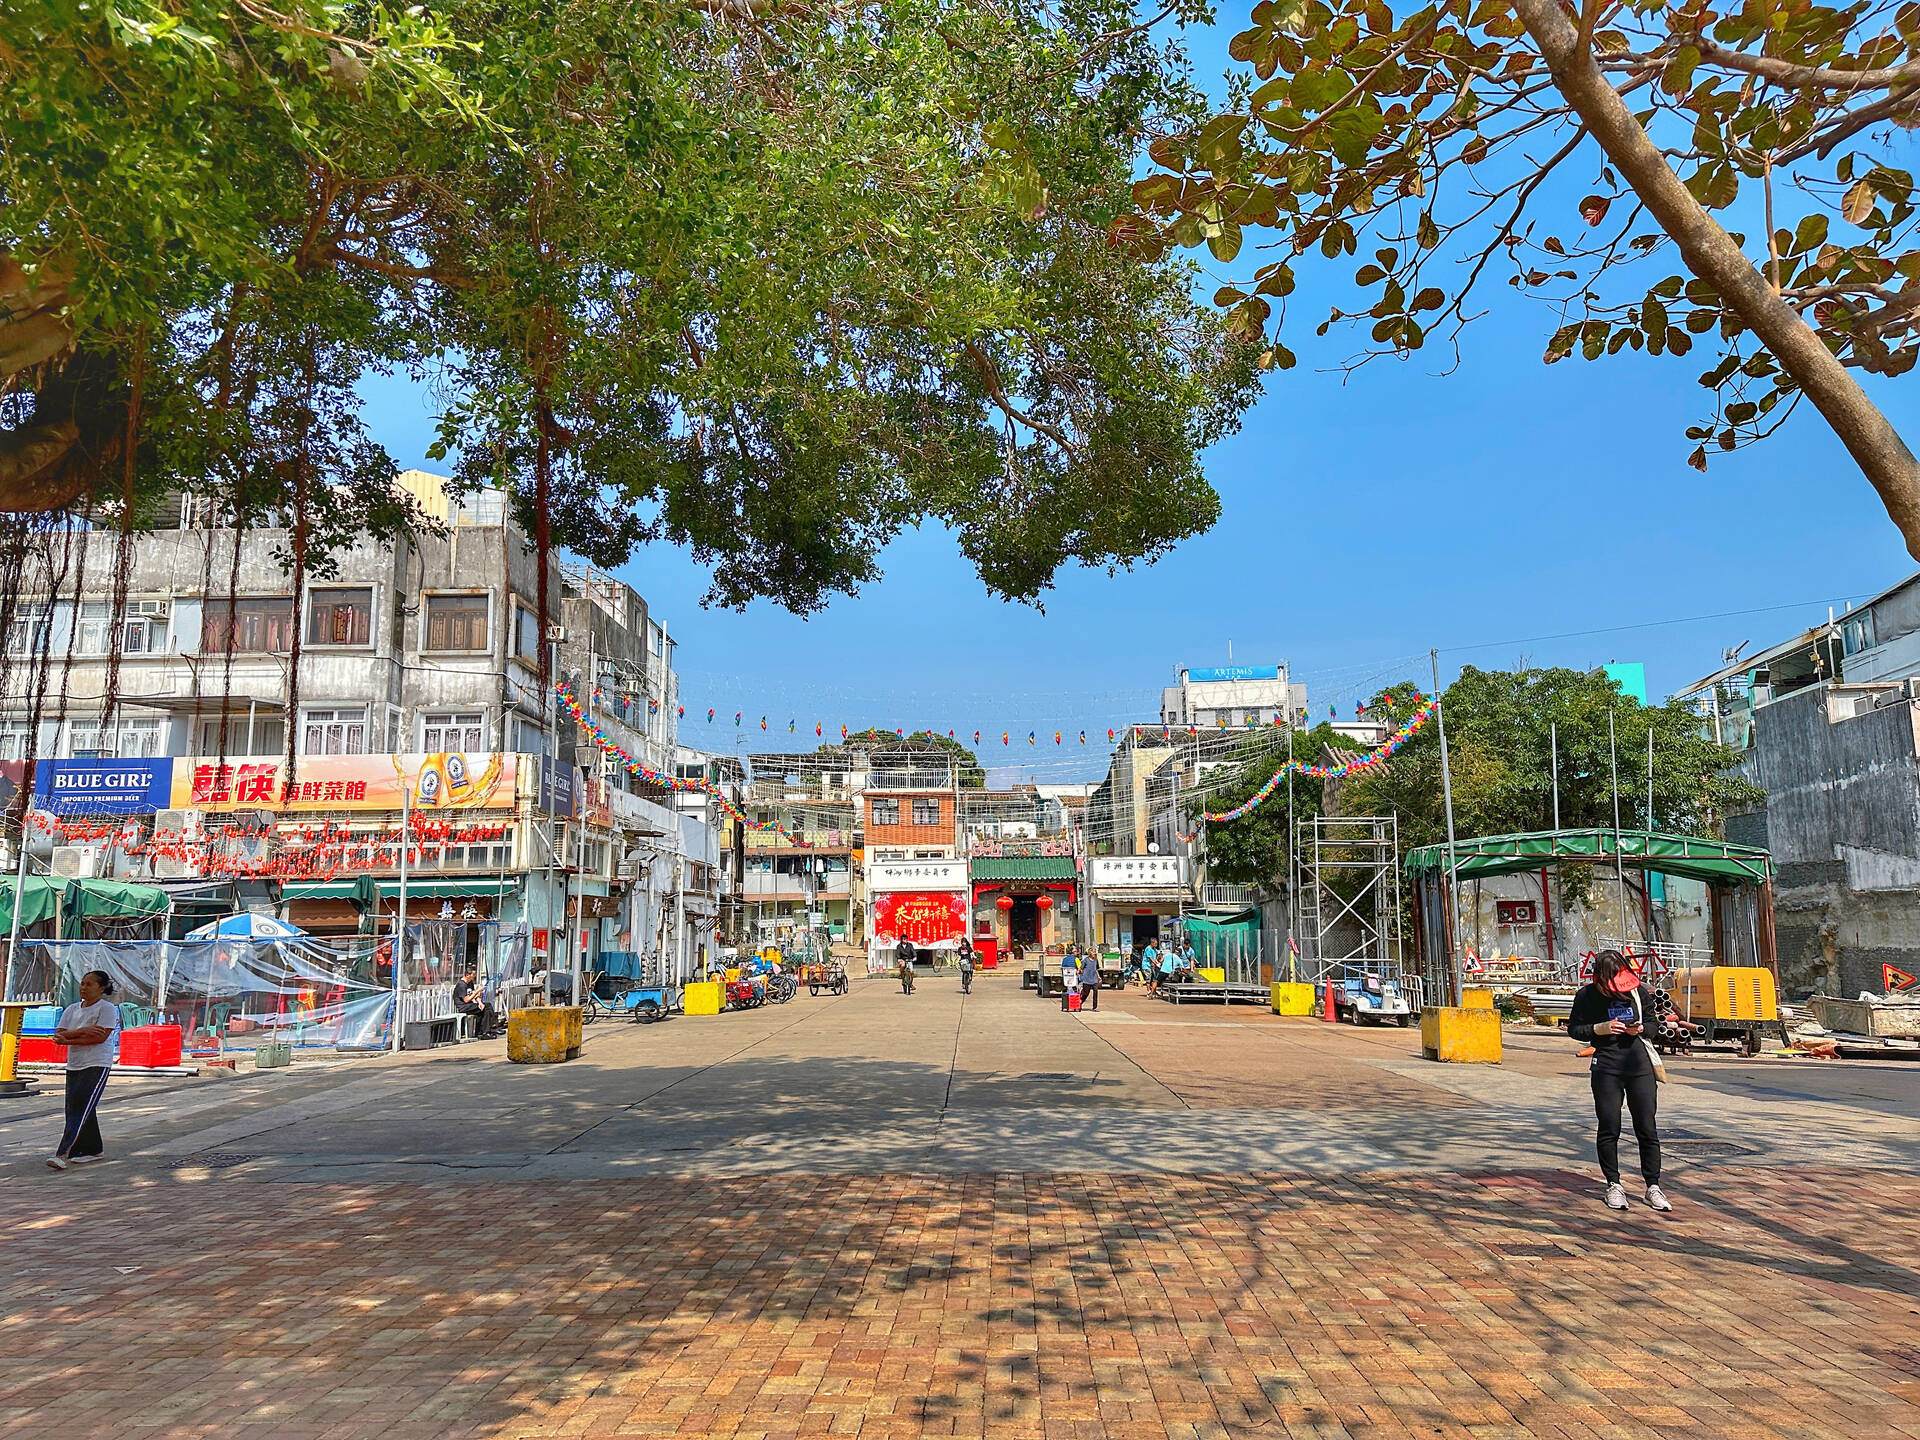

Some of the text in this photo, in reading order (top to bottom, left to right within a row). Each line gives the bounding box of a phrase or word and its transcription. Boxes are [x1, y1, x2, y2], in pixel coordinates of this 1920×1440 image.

[1214, 668, 1253, 676] ARTEMIS
[54, 774, 102, 788] BLUE
[279, 781, 368, 801] 海鮮菜館
